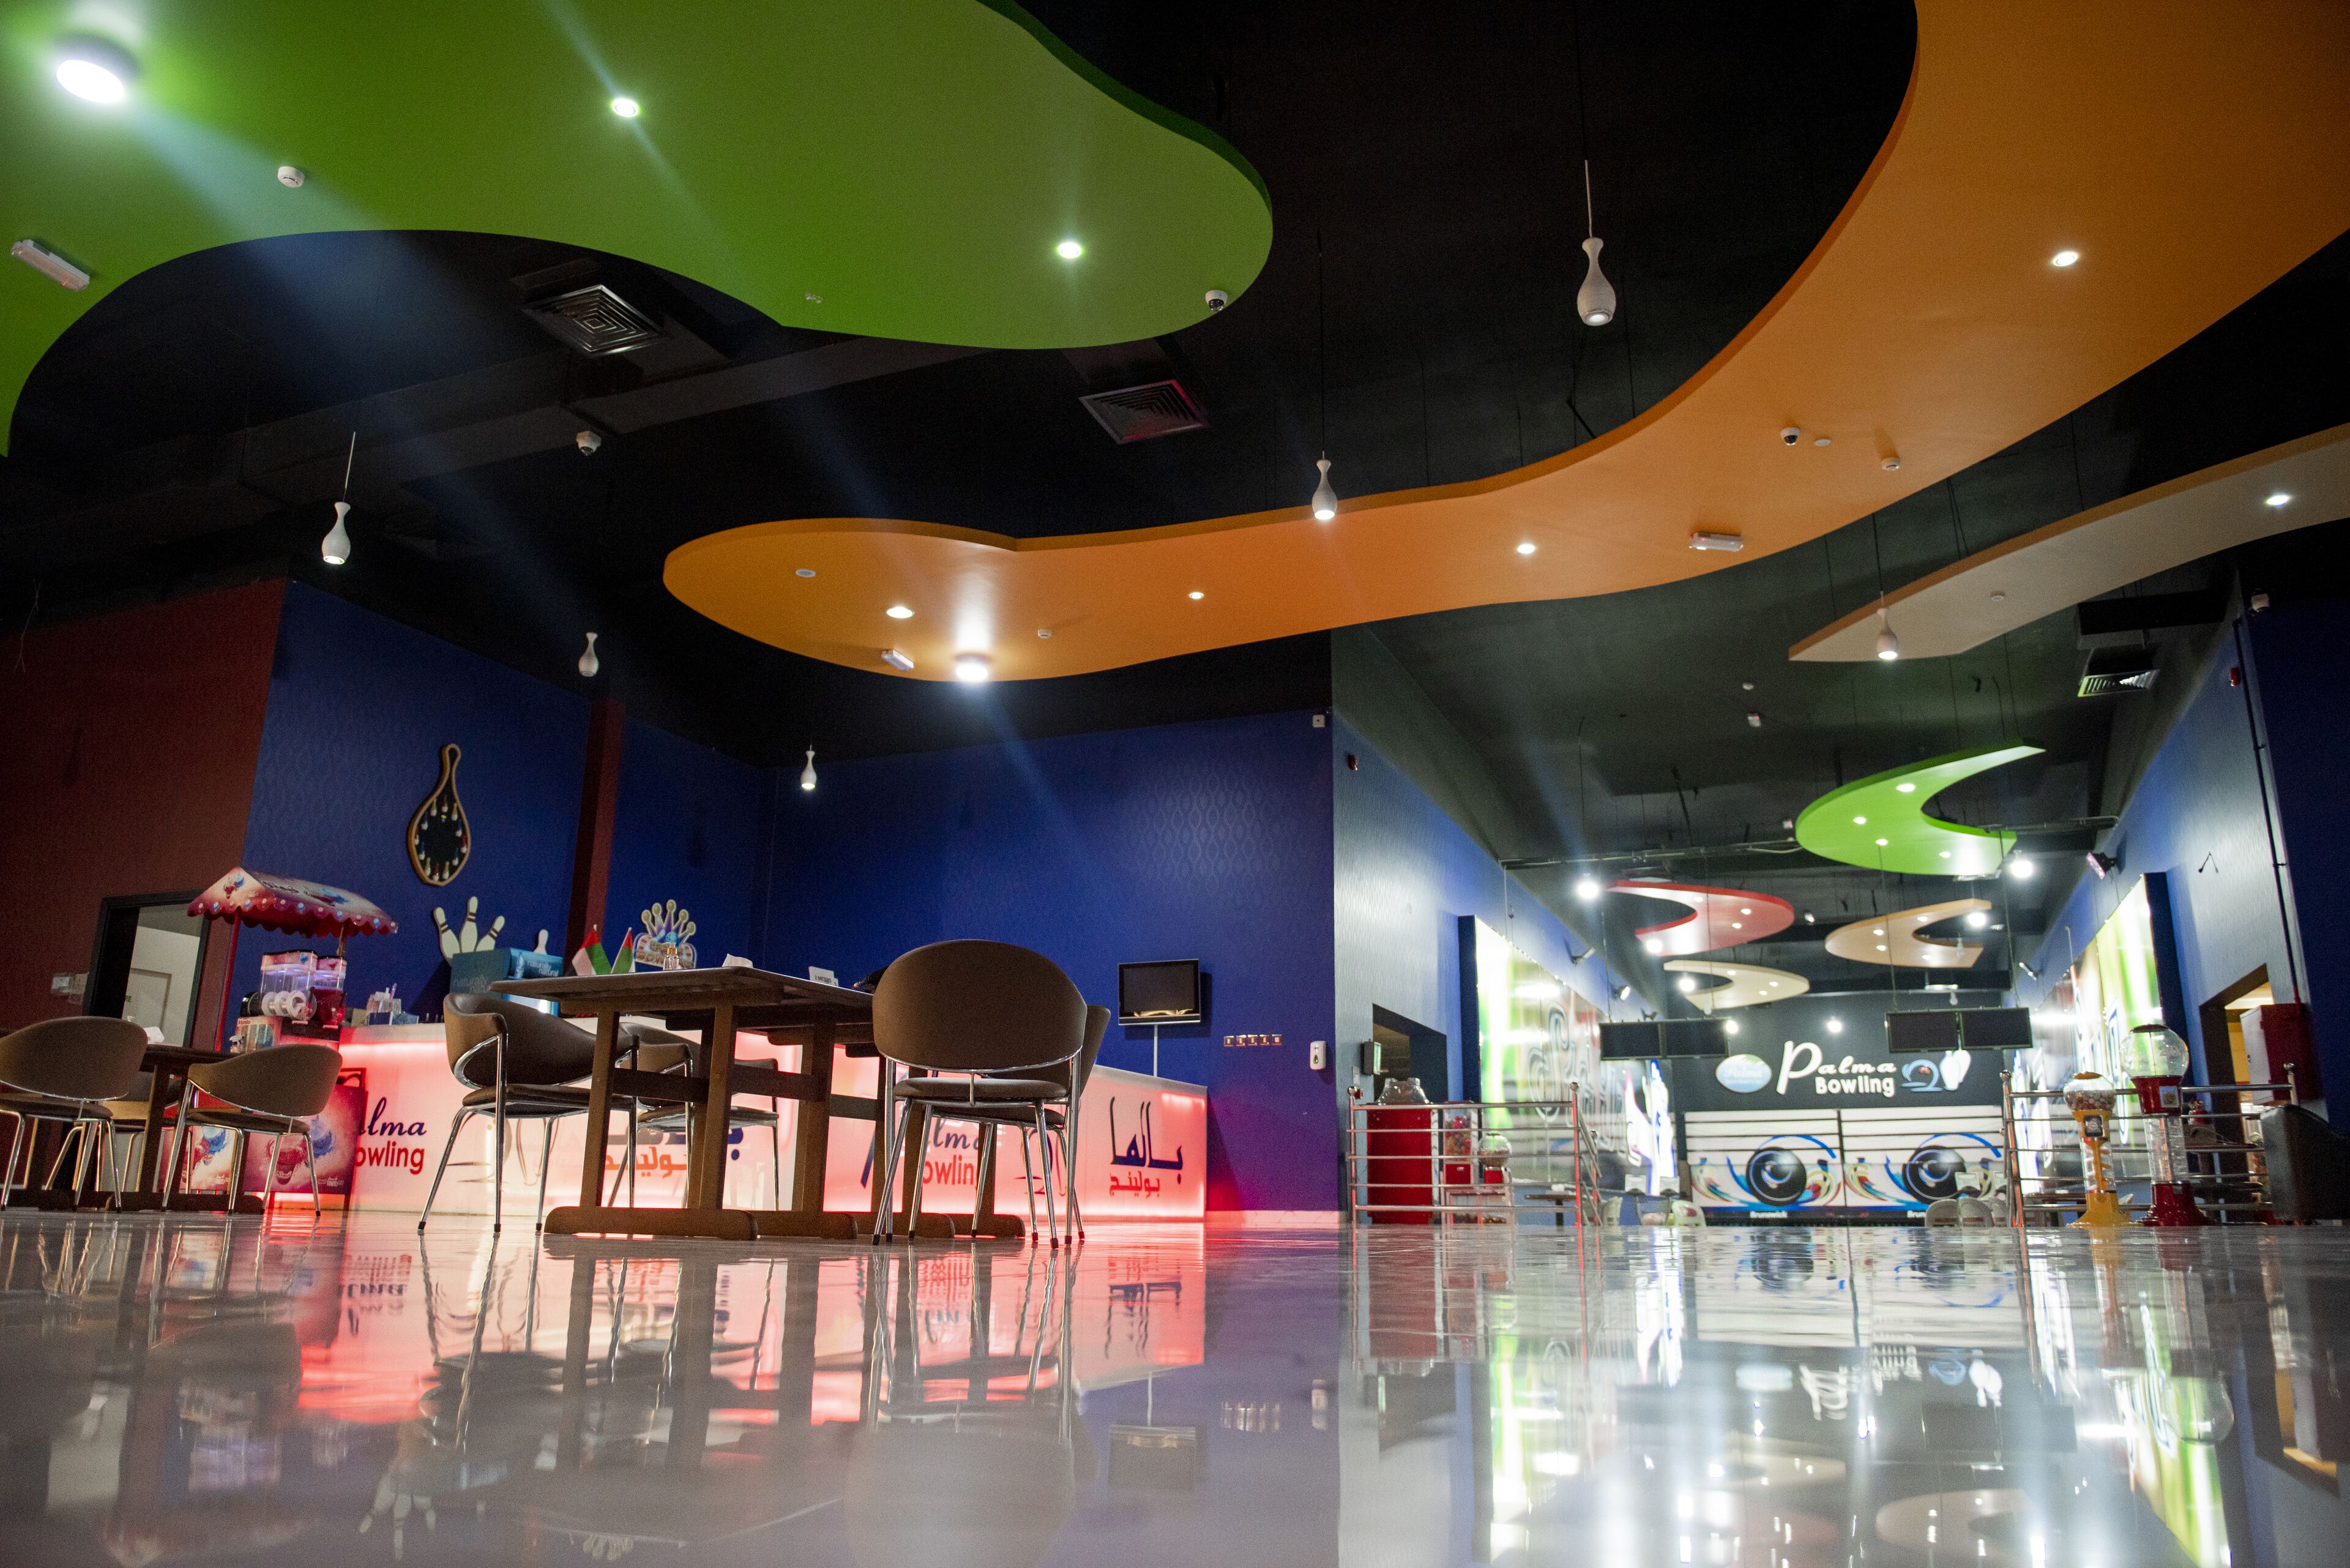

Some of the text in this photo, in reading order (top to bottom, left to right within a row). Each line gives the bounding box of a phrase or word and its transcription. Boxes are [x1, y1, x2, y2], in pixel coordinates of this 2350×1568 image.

[1776, 1040, 1897, 1096] Palma
[1815, 1075, 1895, 1098] Bowling
[359, 1097, 427, 1136] lma
[355, 1140, 425, 1175] owling
[1110, 1096, 1184, 1185] بالما
[1109, 1170, 1160, 1198] بولينج
